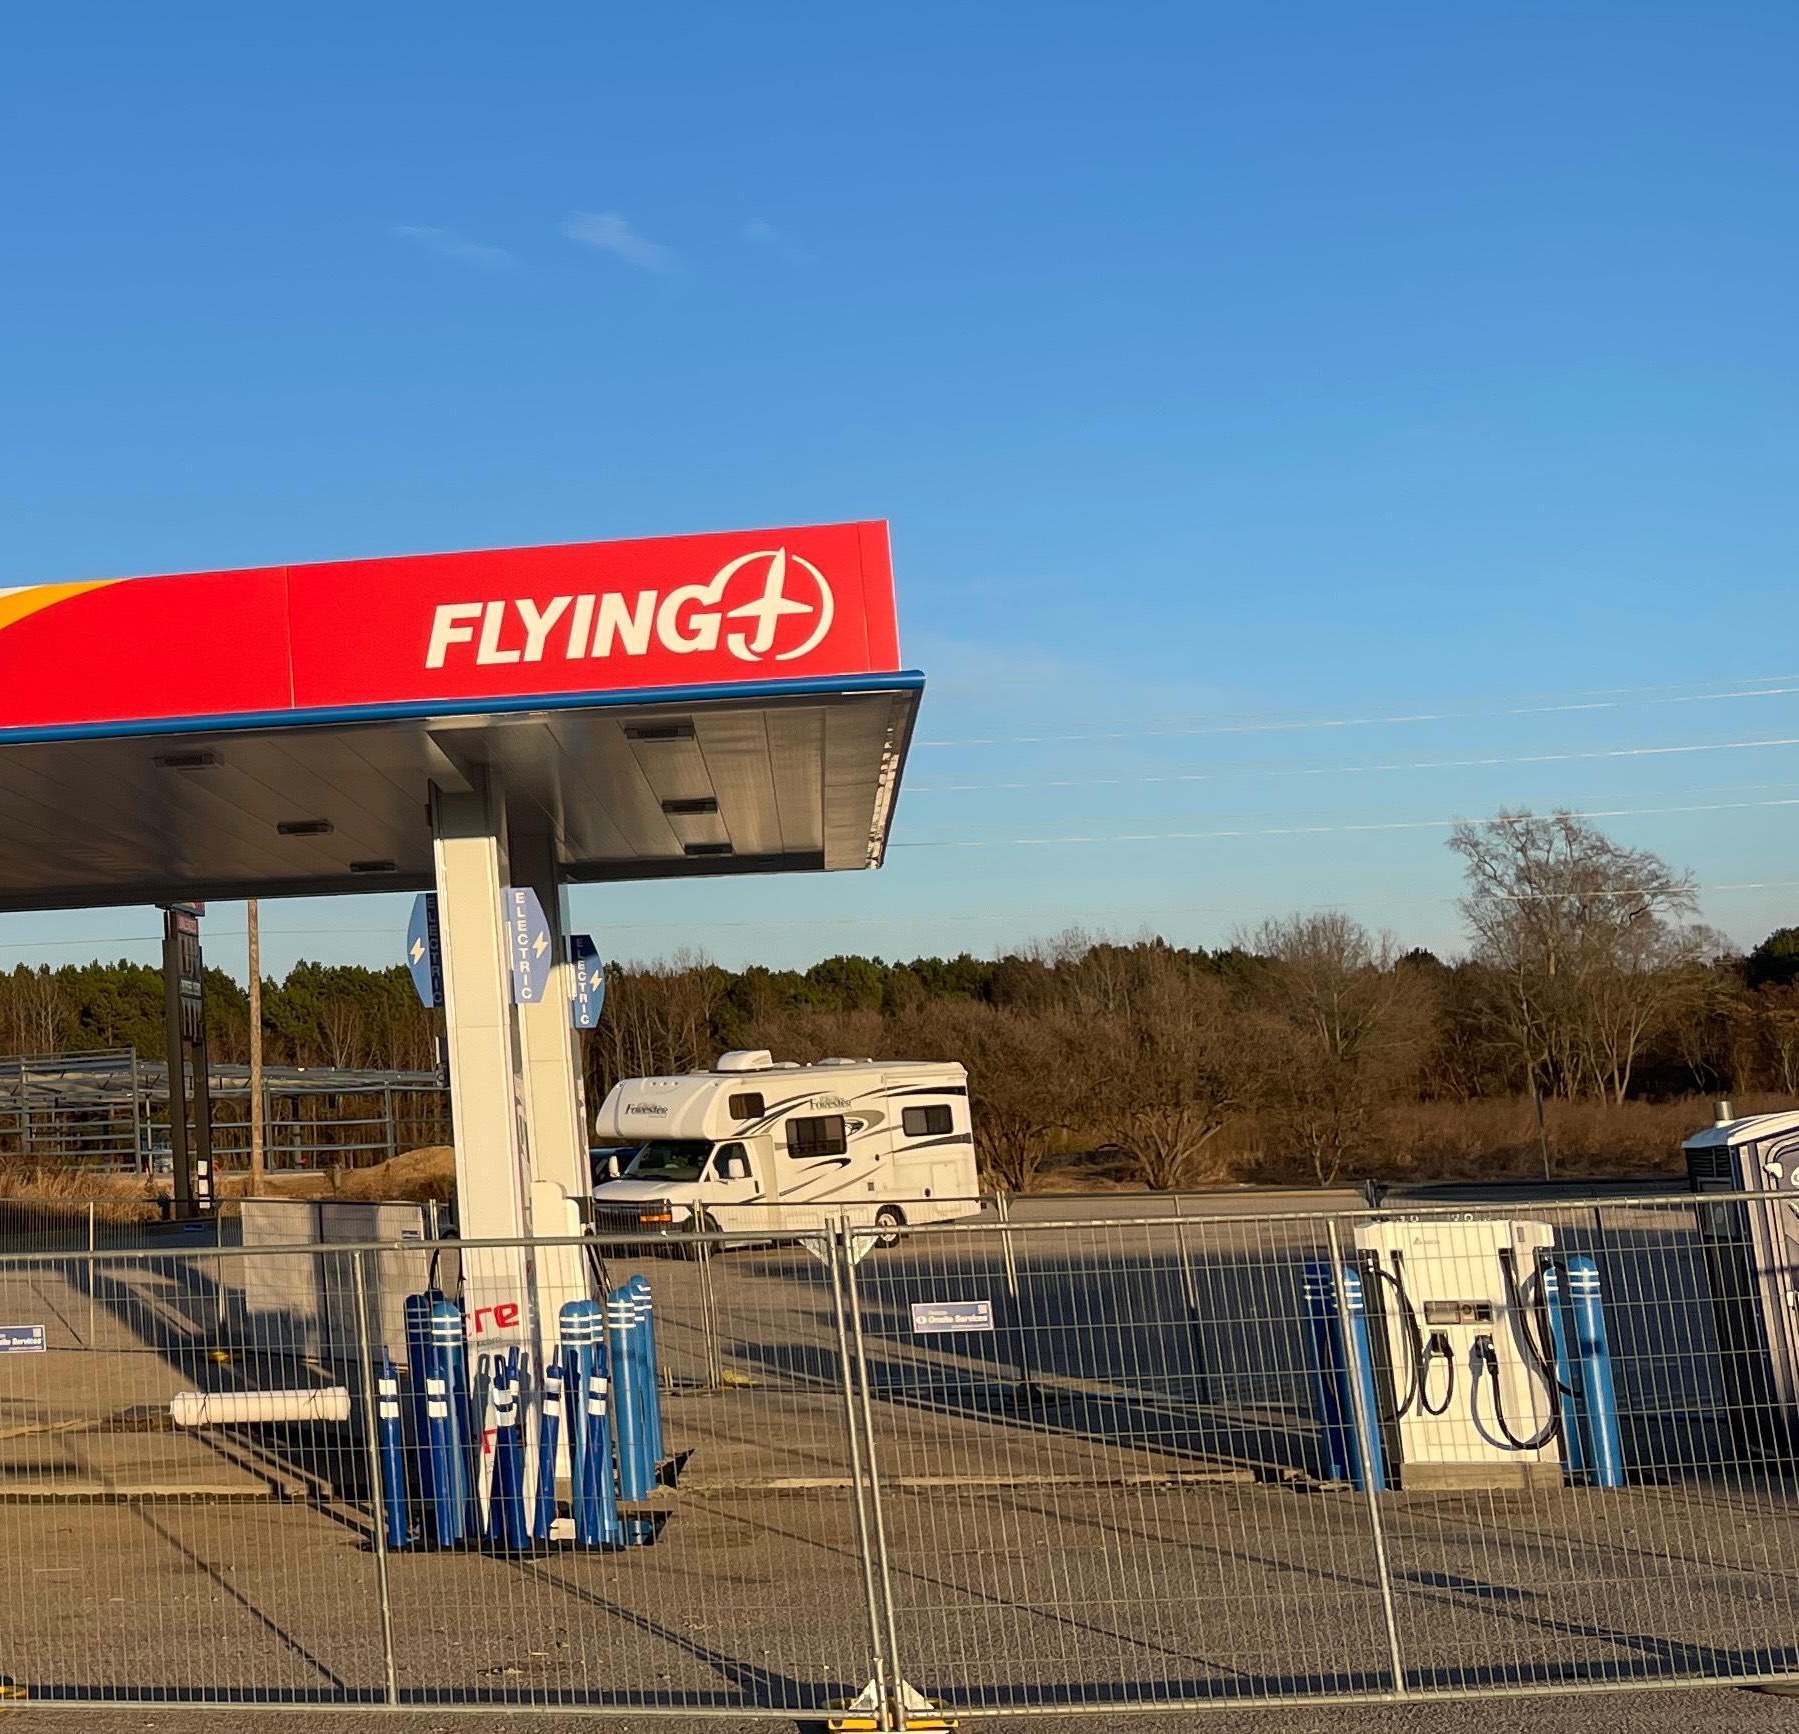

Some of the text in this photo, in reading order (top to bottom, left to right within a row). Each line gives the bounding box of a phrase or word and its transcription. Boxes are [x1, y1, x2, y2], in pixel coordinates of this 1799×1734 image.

[424, 584, 722, 669] FLYING
[426, 897, 443, 1002] ELECTRIC
[515, 892, 532, 999] ELECTRIC
[576, 938, 590, 1025] ELECTRIC
[12, 1337, 42, 1346] Services
[465, 1302, 520, 1338] re
[954, 1313, 988, 1323] Services
